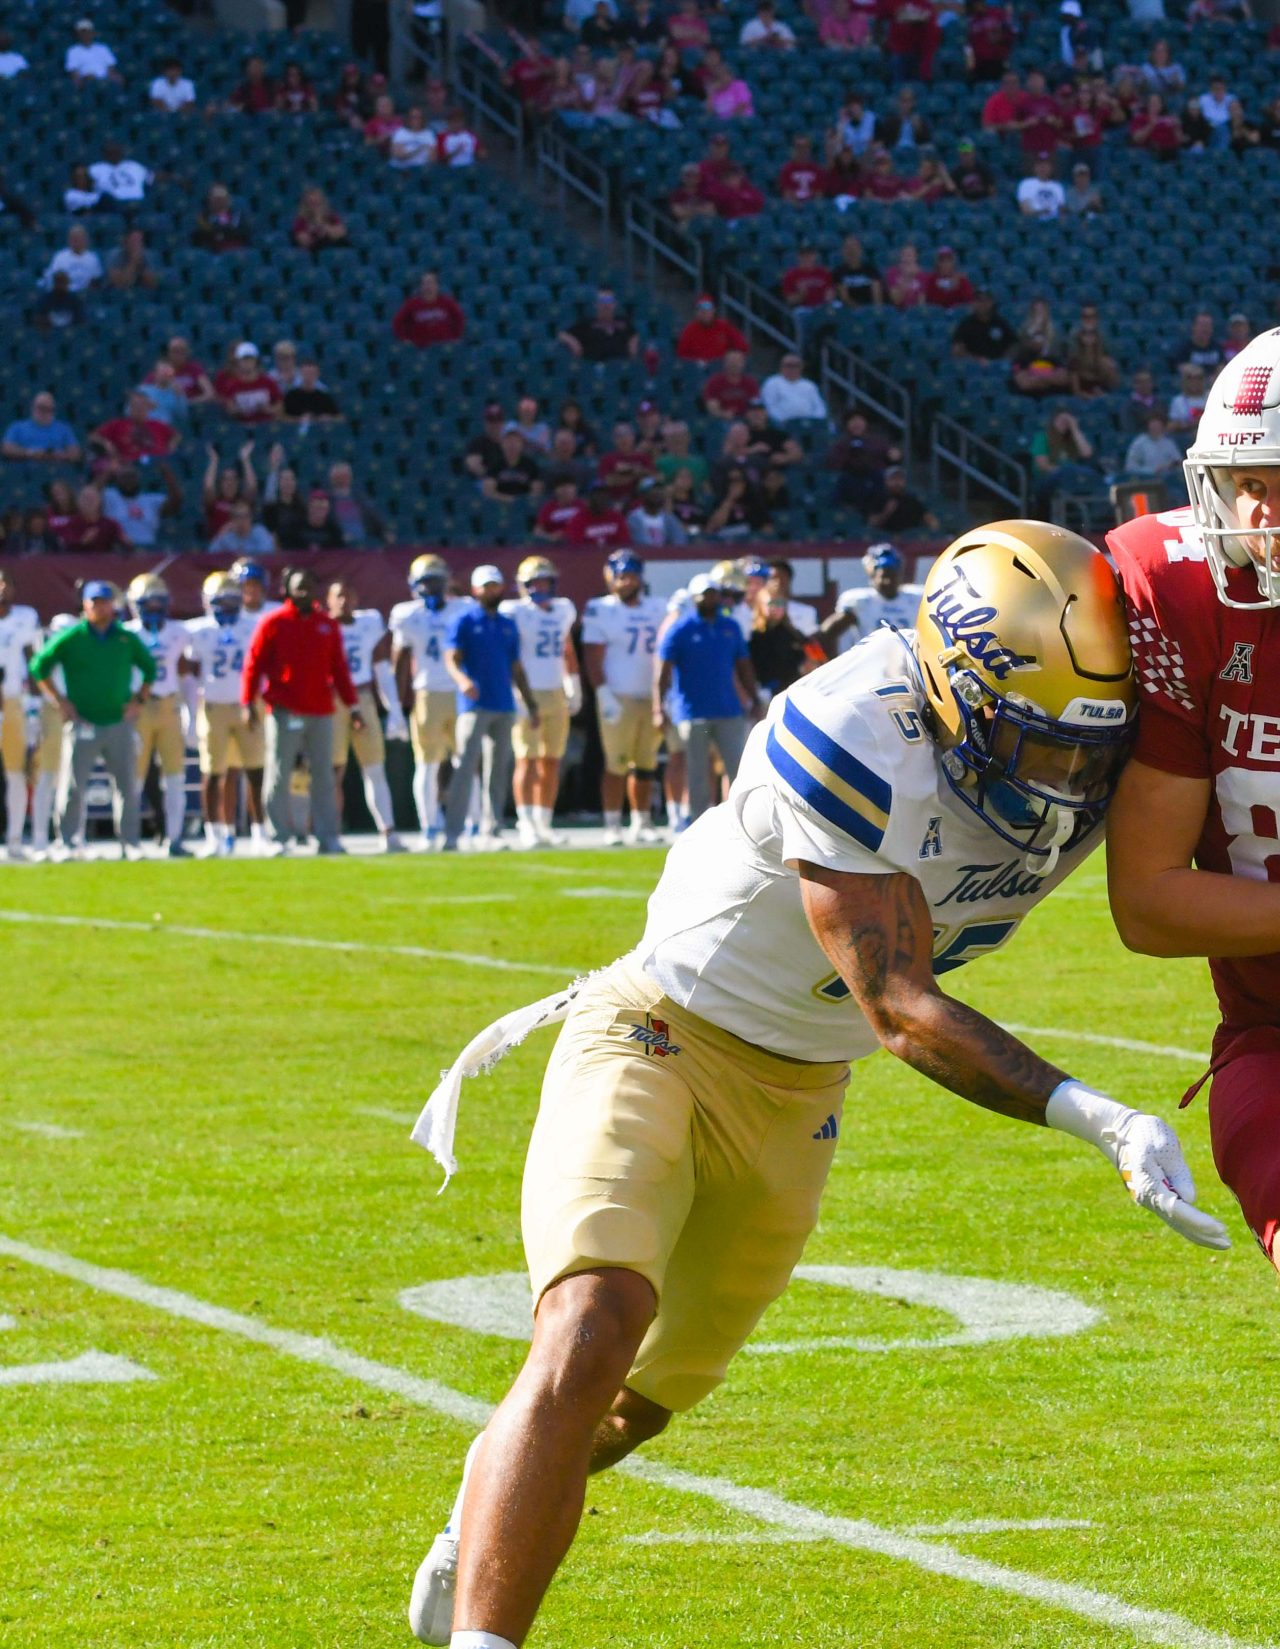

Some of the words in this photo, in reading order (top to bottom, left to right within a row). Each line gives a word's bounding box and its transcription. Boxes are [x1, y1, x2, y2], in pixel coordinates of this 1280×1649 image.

[1218, 432, 1265, 446] TUFF
[927, 565, 1026, 681] Tulsa
[1080, 703, 1125, 719] TULSA
[934, 858, 1045, 907] Tulsa
[624, 1023, 682, 1056] Tulsa
